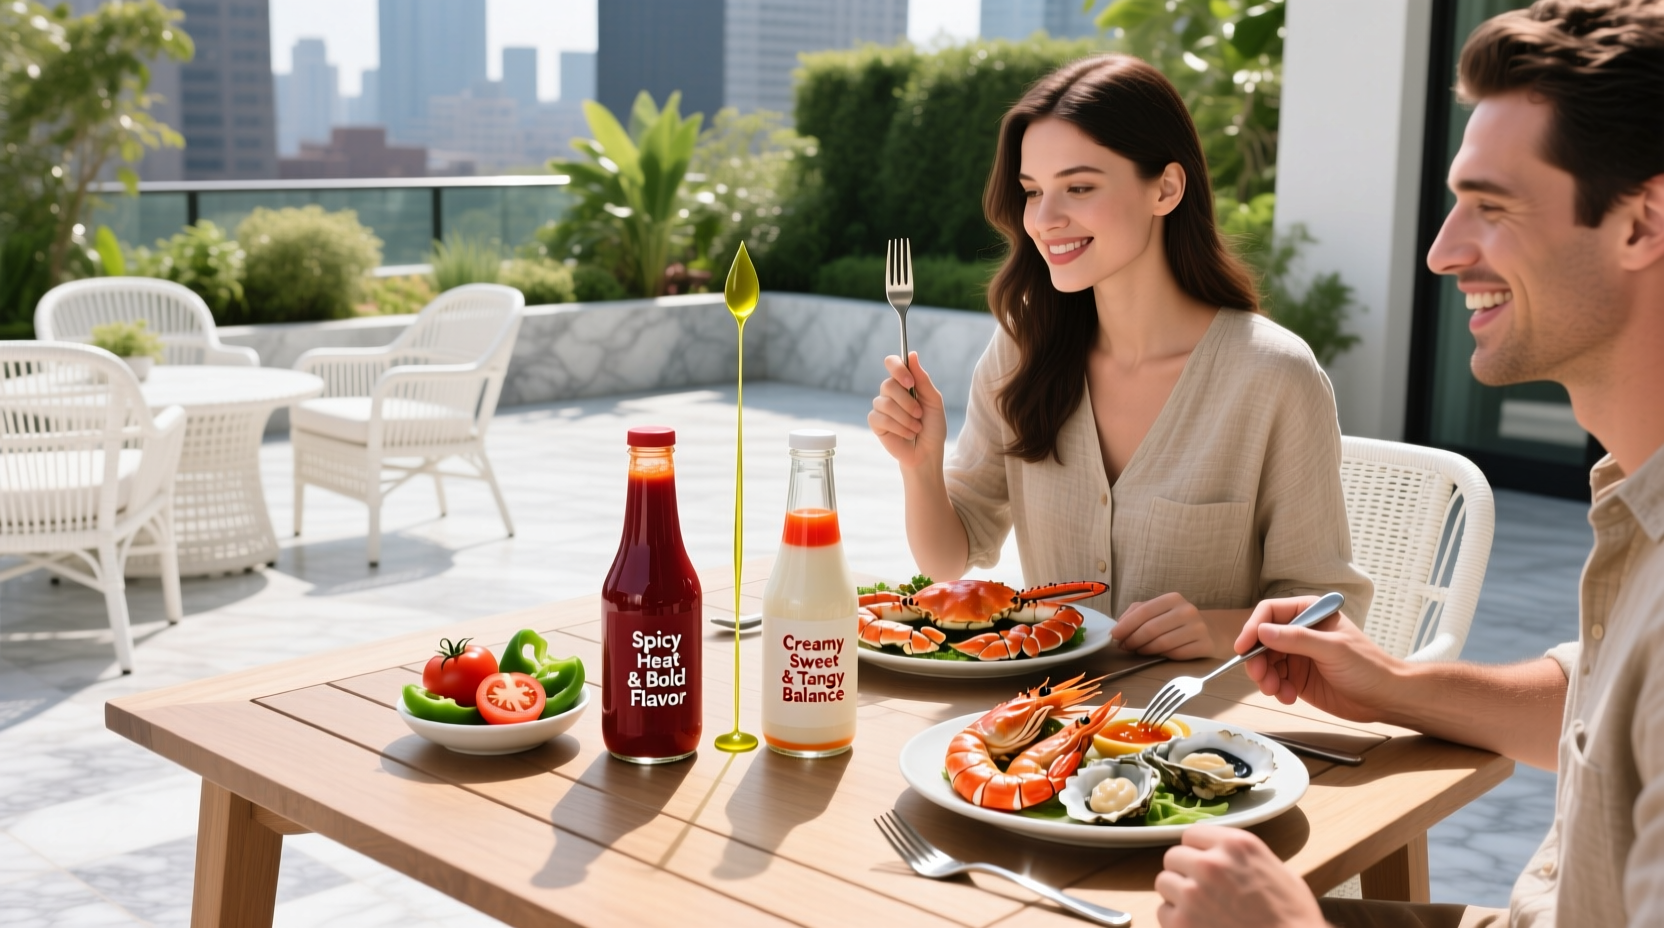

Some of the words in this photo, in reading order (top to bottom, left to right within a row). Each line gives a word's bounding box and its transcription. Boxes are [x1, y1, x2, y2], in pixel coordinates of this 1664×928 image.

[632, 630, 682, 653] Spicy
[782, 634, 845, 654] Creamy
[637, 652, 681, 669] Heat
[789, 653, 840, 669] Sweet
[627, 671, 642, 688] &
[646, 667, 686, 688] Bold
[781, 669, 795, 686] &
[796, 670, 845, 689] Tangy
[630, 689, 687, 707] Flavor
[782, 686, 845, 703] Balance
